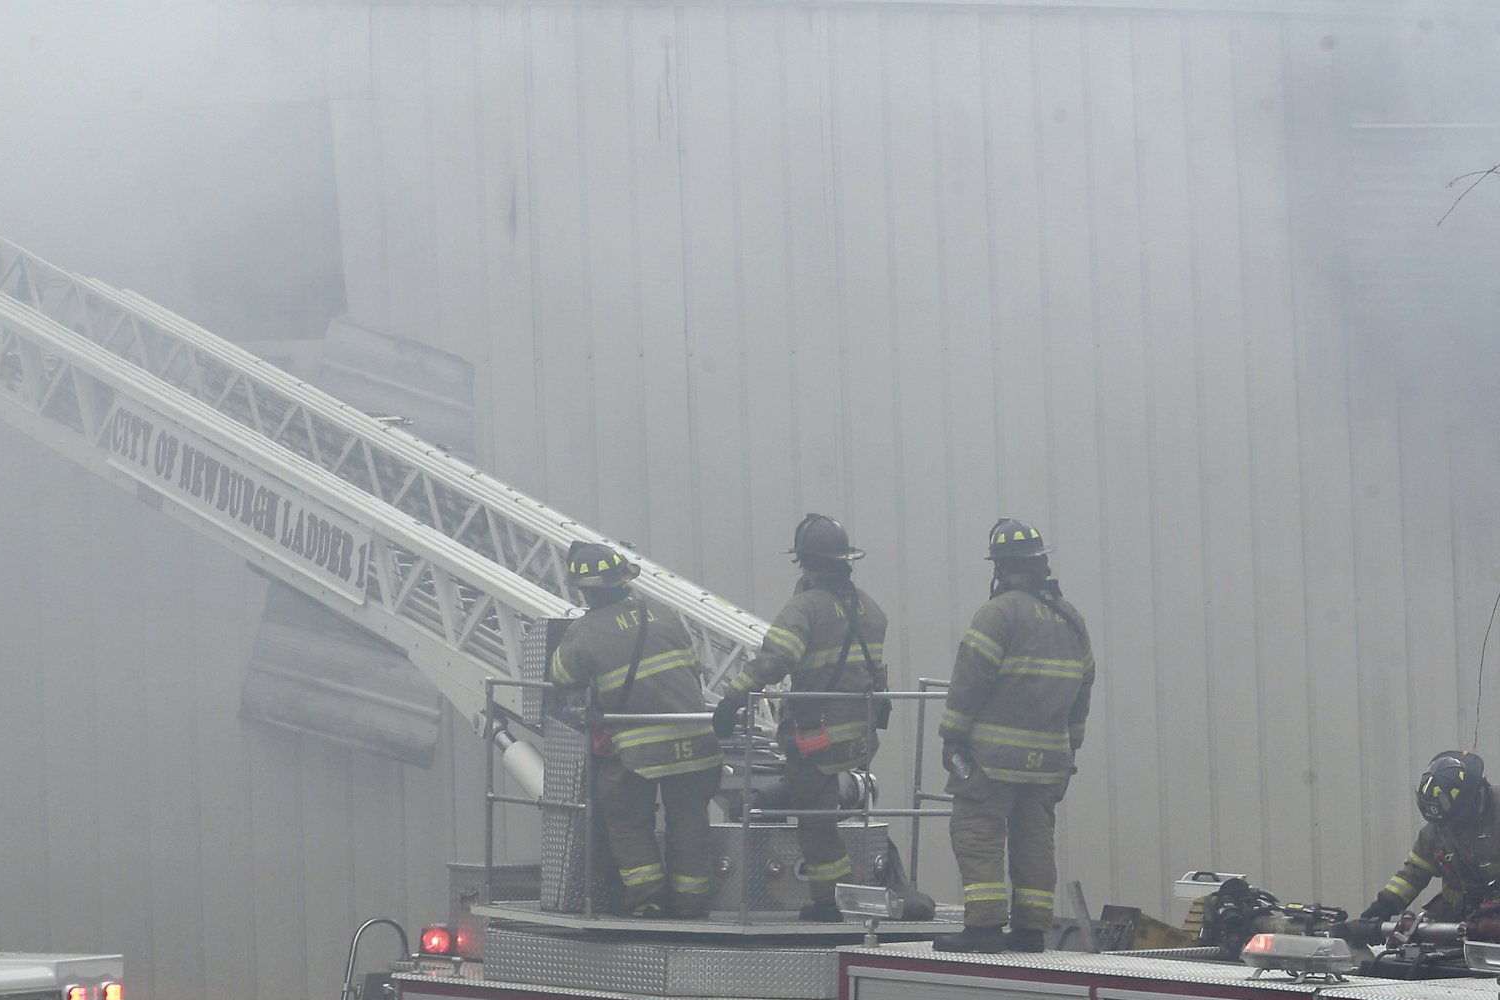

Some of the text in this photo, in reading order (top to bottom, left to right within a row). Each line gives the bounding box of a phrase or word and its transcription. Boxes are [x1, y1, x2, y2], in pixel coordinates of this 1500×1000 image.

[111, 406, 367, 589] CITY OF NEWBURGH LADDER 1
[673, 740, 693, 760] 15
